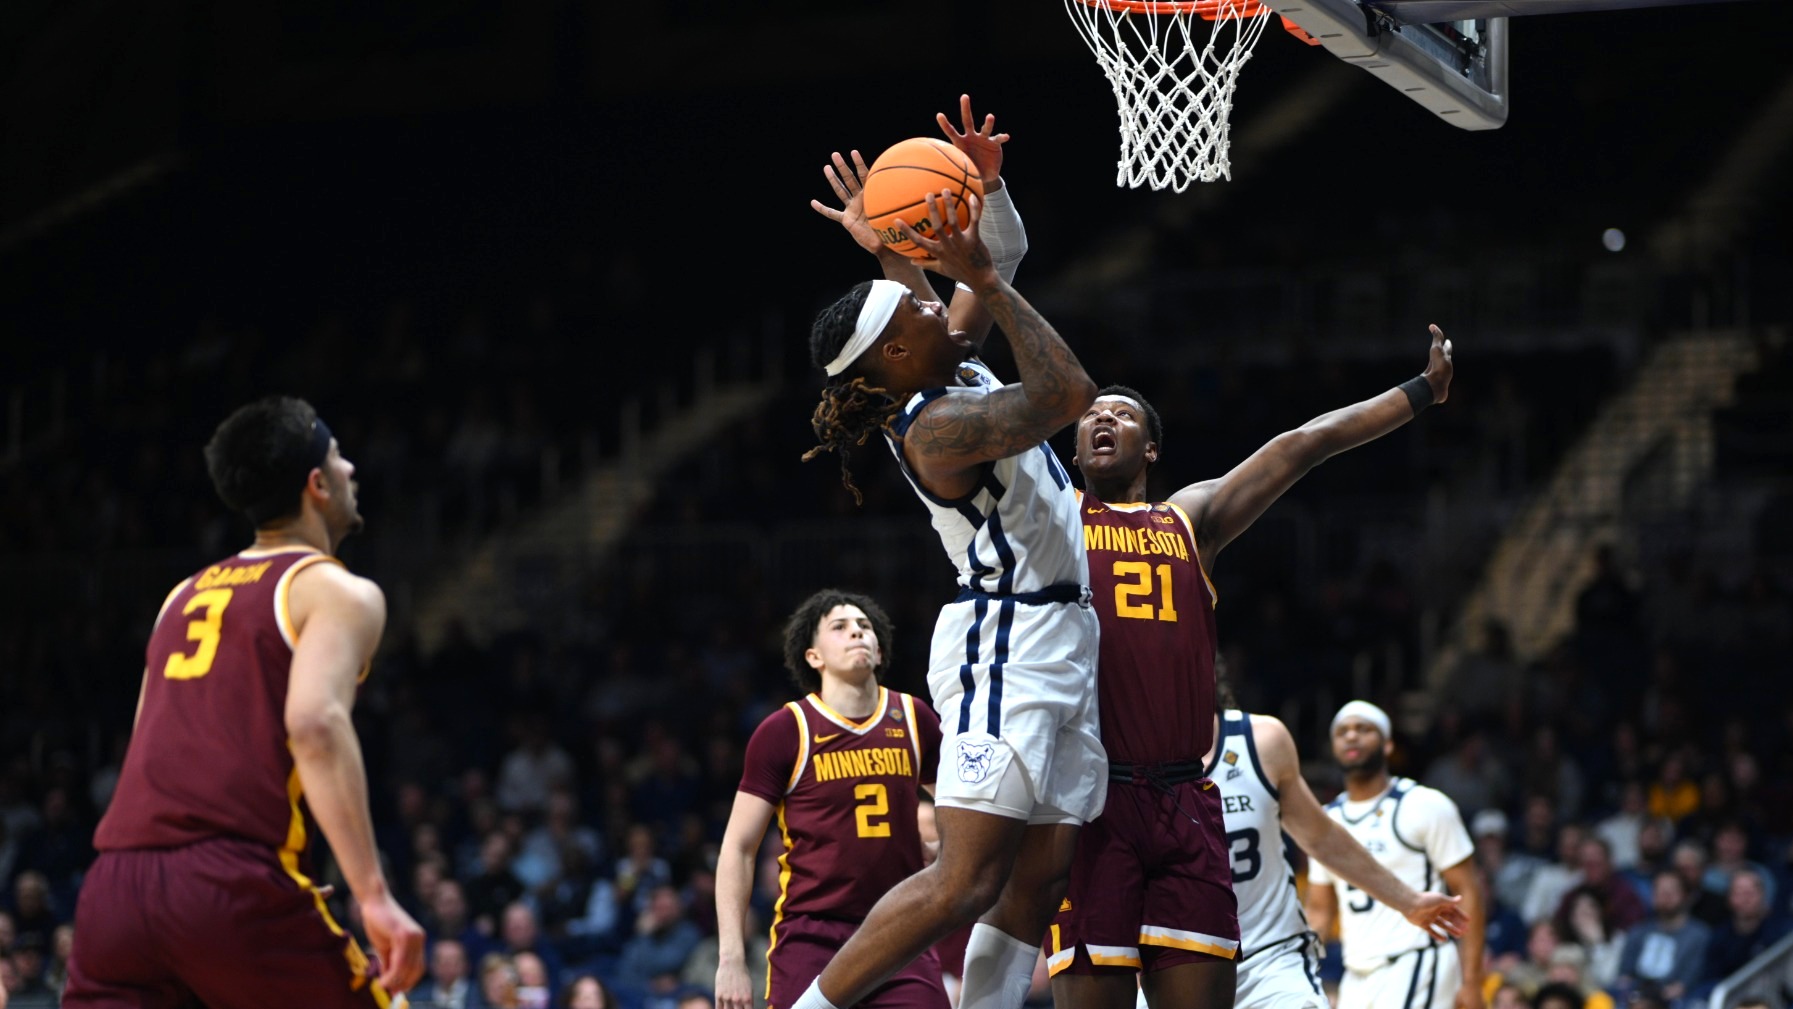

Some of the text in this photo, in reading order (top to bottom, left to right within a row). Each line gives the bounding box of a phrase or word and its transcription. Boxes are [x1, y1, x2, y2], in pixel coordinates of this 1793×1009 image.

[1083, 525, 1189, 562] MINNESOTA
[1112, 561, 1178, 622] 21
[163, 588, 233, 680] 3
[813, 748, 912, 782] MINNESOTA
[854, 783, 891, 838] 2
